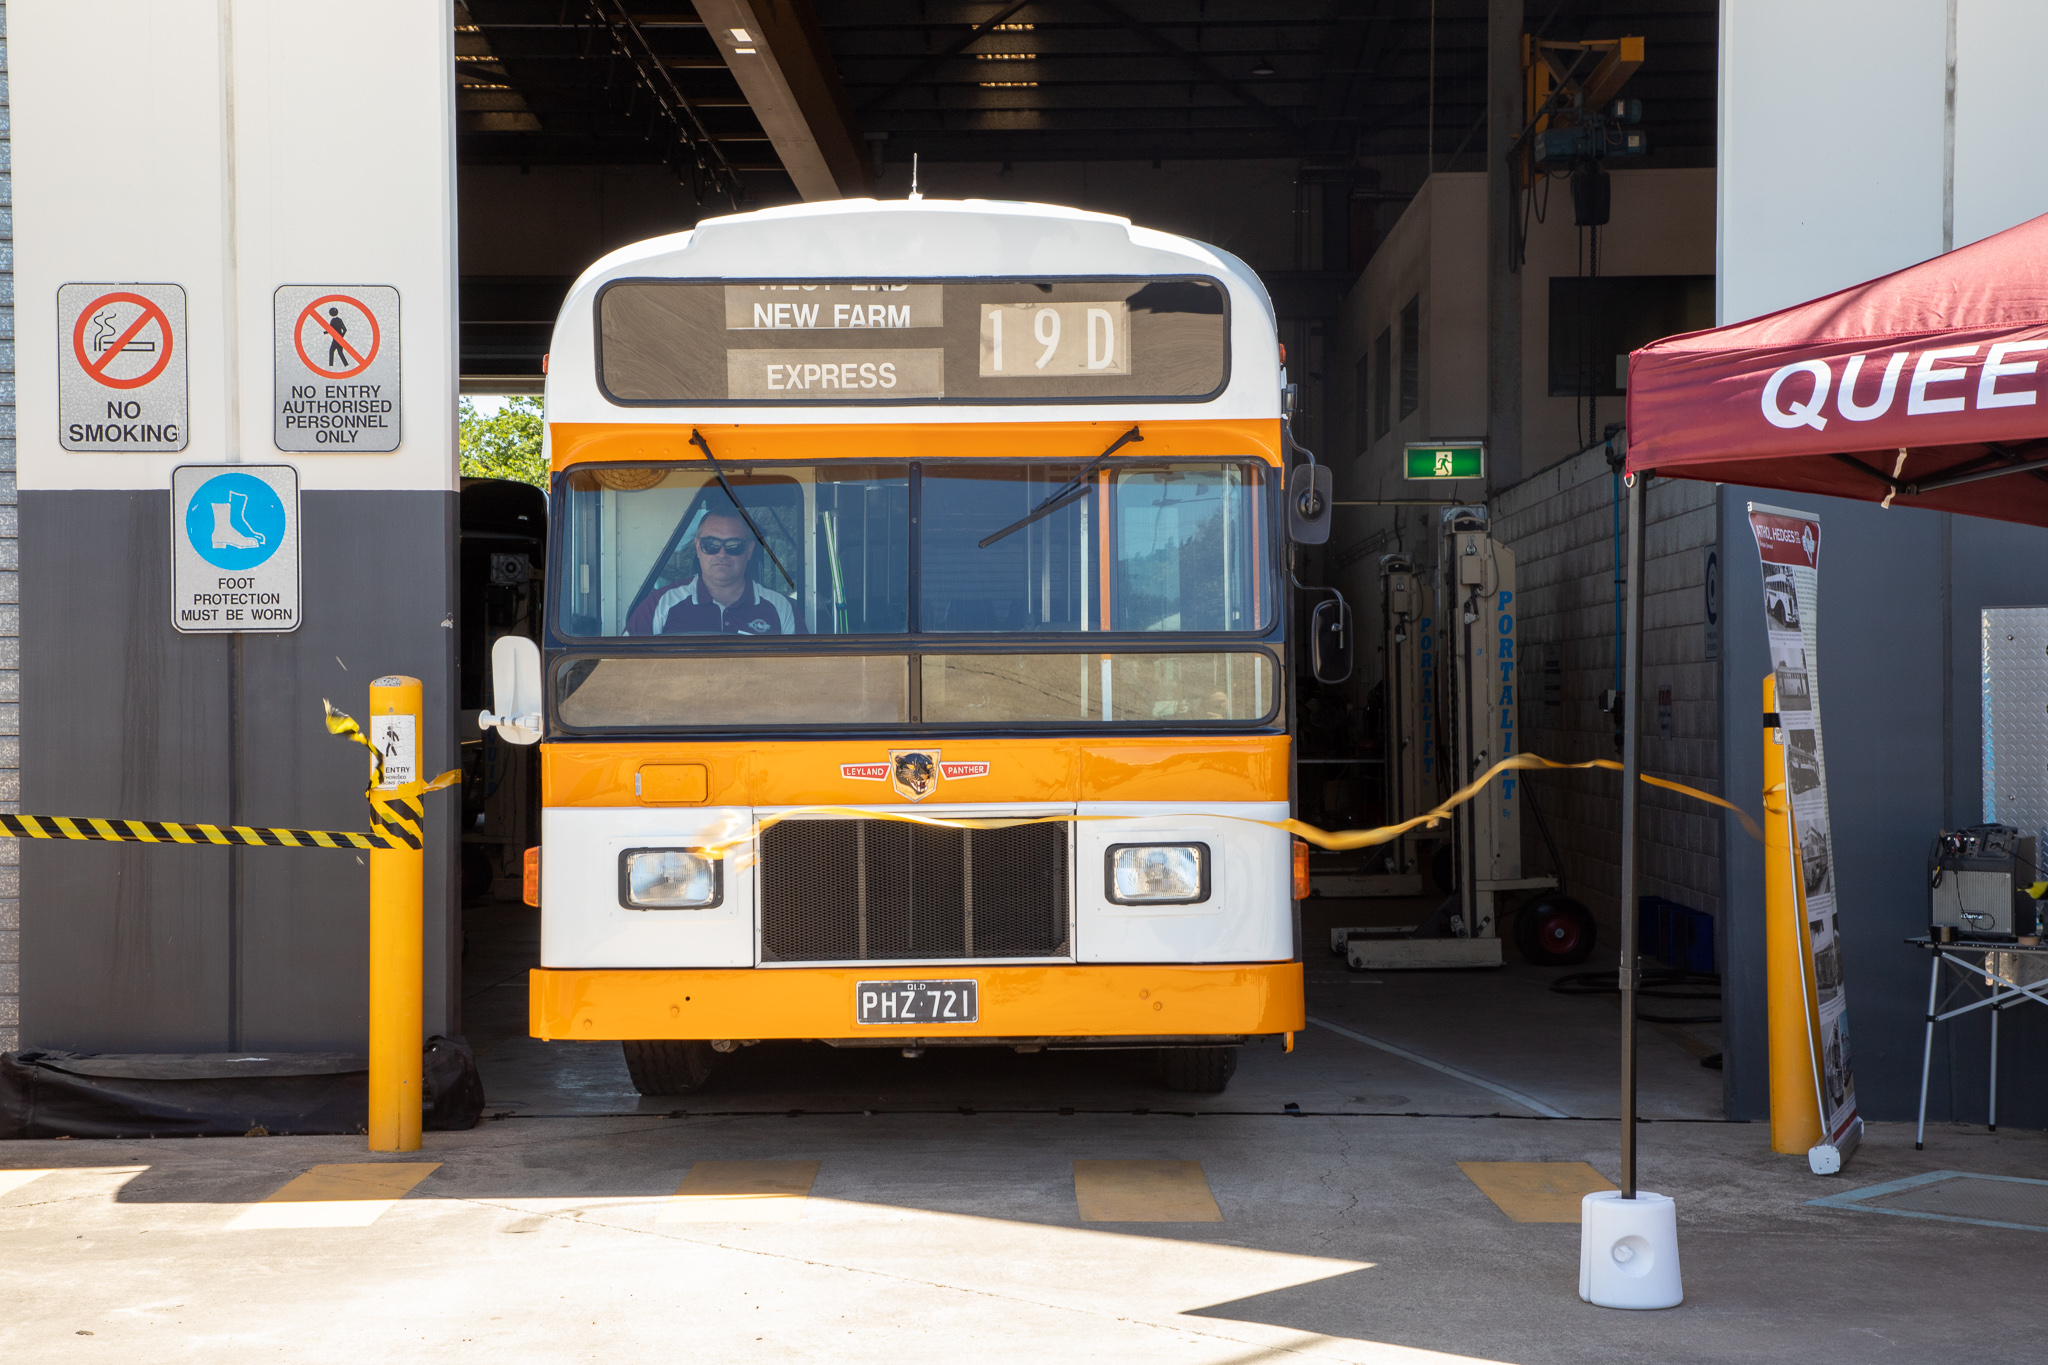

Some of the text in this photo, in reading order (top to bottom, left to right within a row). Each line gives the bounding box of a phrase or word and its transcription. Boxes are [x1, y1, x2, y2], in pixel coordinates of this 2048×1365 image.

[753, 303, 911, 328] NEW FARM
[767, 362, 897, 390] EXPRESS
[291, 385, 381, 399] NO ENTRY
[1761, 339, 2048, 432] QUEE
[107, 401, 141, 419] NO
[282, 400, 392, 414] AUTHORISED
[286, 415, 388, 429] PERSONNEL
[69, 424, 179, 443] SMOKING
[316, 430, 358, 444] ONLY
[1772, 528, 1795, 544] HEDGES
[218, 577, 255, 590] FOOT
[194, 593, 280, 605] PROTECTION
[181, 608, 292, 621] MUST BE WORN
[1420, 617, 1434, 773] PORTALIFT
[846, 765, 984, 776] LEYLAND PANTHER
[862, 990, 968, 1019] PHZ 721
